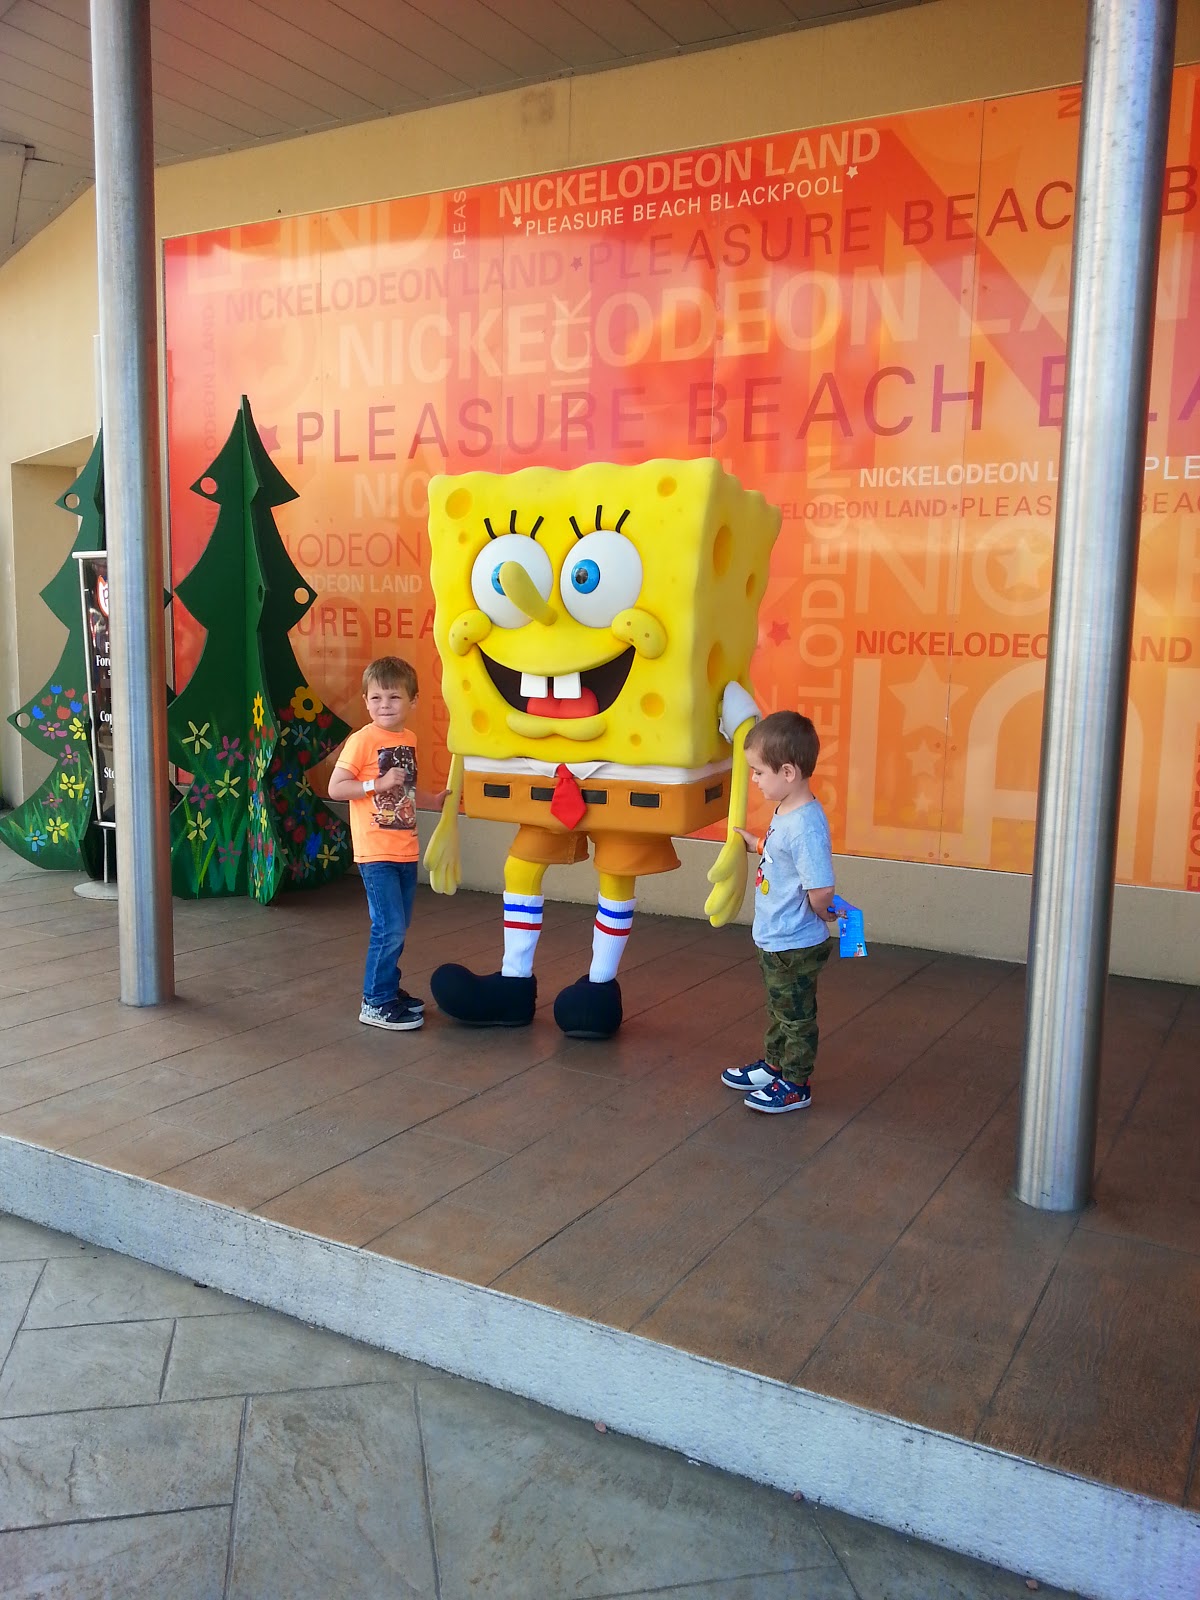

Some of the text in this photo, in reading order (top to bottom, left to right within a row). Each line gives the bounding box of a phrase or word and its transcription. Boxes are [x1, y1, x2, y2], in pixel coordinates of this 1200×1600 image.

[499, 127, 881, 218] NICKELODEON LAND
[525, 175, 843, 236] PLEASURE BEACH BLACKPOOL
[587, 205, 872, 283] PLEASURE
[902, 179, 1074, 246] BEAC
[226, 250, 564, 325] NICKELODEON LAND
[337, 259, 922, 391] NICKELODEON
[296, 387, 647, 466] PLEASURE
[688, 360, 986, 446] BEACH
[859, 460, 1039, 489] NICKELODEON
[886, 499, 948, 518] LAND
[961, 494, 1052, 519] PLEAS
[370, 574, 423, 594] LAND
[855, 629, 1051, 660] NICKELODEO
